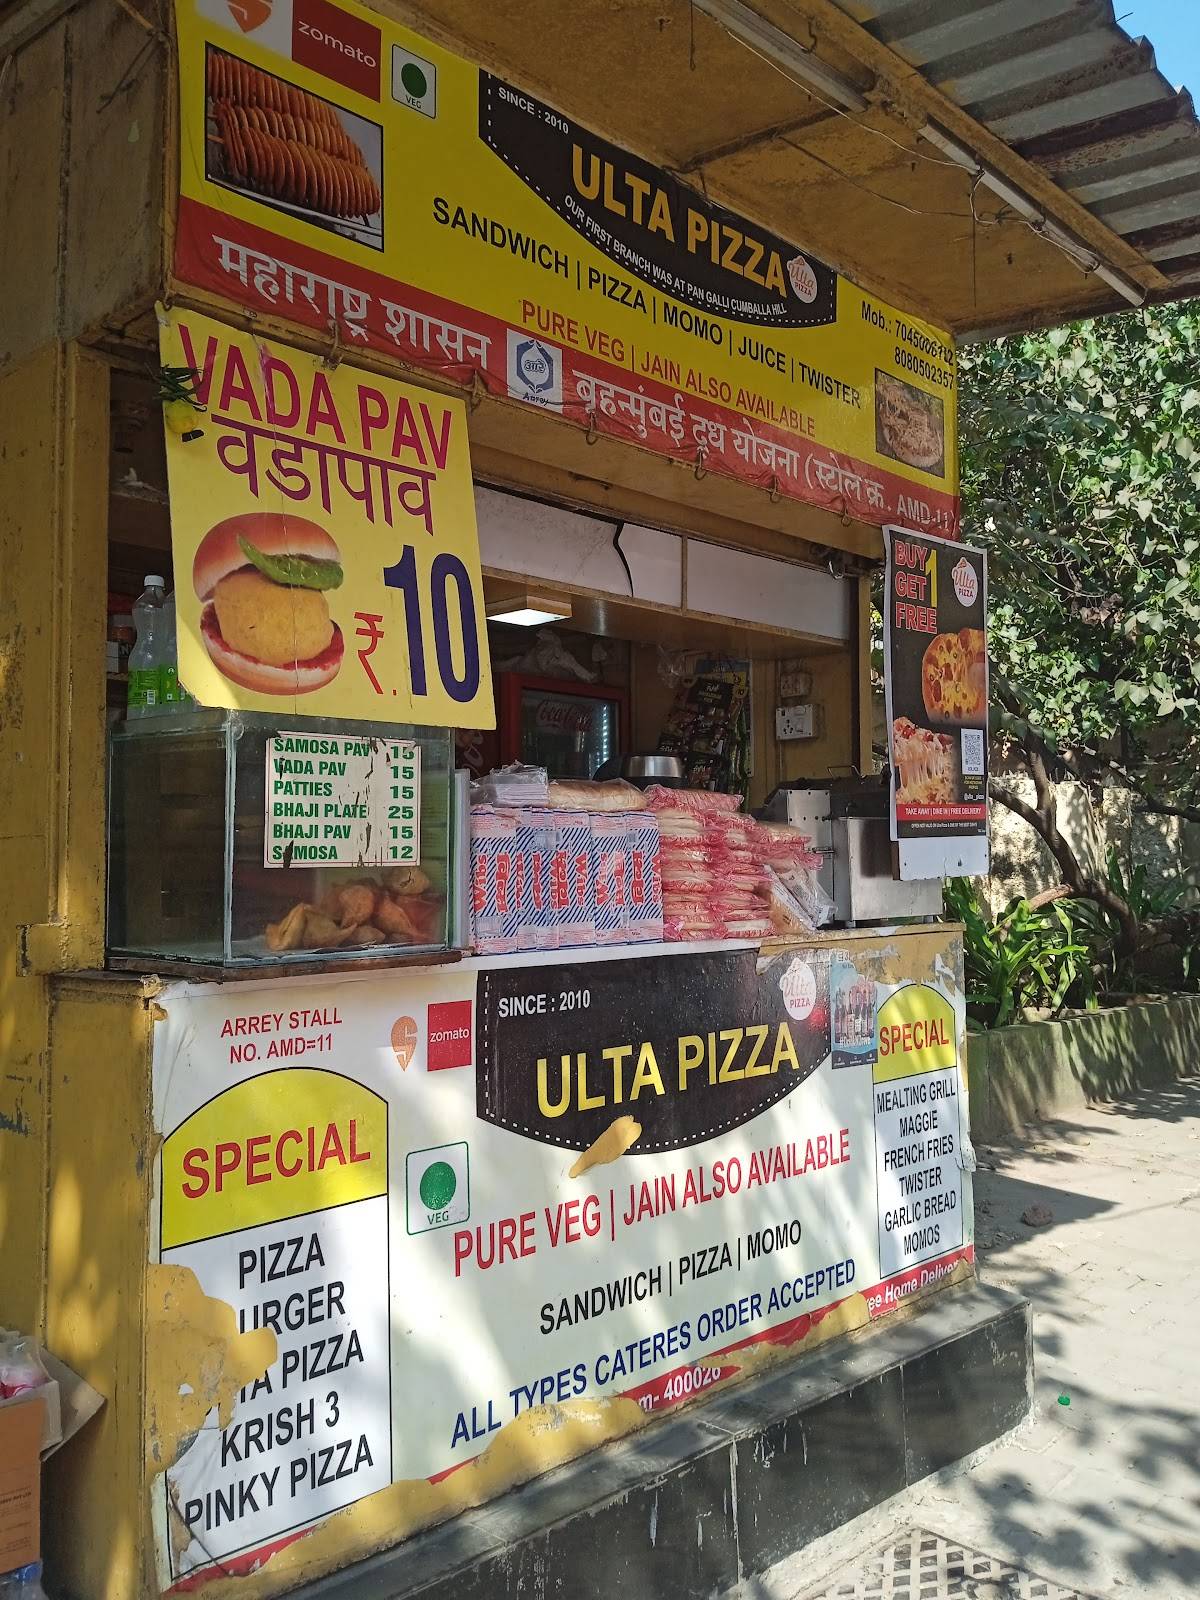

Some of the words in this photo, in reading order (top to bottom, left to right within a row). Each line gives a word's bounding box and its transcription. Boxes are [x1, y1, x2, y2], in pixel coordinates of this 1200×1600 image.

[298, 20, 376, 68] zomato
[405, 94, 422, 109] VEG
[497, 87, 535, 114] SINCE
[543, 110, 569, 134] 2010
[572, 144, 675, 243] ULTA
[687, 208, 787, 298] PIZZA
[564, 195, 584, 222] OUR
[585, 216, 612, 246] FIRST
[613, 241, 651, 273] BRANCH
[652, 265, 672, 285] WAS
[674, 275, 685, 291] AT
[687, 283, 704, 300] PAN
[706, 291, 730, 309] GALLI
[730, 299, 772, 315] CUMBALLA
[771, 302, 787, 315] HILL
[212, 234, 372, 342] महाराष्ट्र
[379, 298, 492, 371] शासन
[433, 196, 569, 278] SANDWICH
[589, 265, 646, 313] PIZZA
[664, 300, 723, 346] MOMO
[739, 338, 786, 373] JUICE
[799, 361, 861, 408] TWISTER
[794, 281, 811, 296] PIZZA
[862, 300, 891, 333] Mob.:
[522, 300, 578, 346] PURE
[585, 324, 625, 363] VEG
[641, 351, 680, 384] JAIN
[685, 369, 732, 403] ALSO
[735, 385, 816, 438] AVAILABLE
[895, 346, 954, 390] 8080502357
[177, 324, 346, 444] VADA
[357, 384, 452, 470] PAV
[731, 418, 800, 479] योजना
[211, 413, 436, 536] वडापाव
[895, 540, 928, 571] BUY
[925, 549, 937, 608] 1
[895, 571, 926, 601] GET
[958, 589, 974, 598] PIZZA
[383, 544, 481, 702] 10
[896, 602, 937, 634] FREE
[274, 738, 339, 754] SAMOSA
[344, 743, 370, 757] PAV
[274, 759, 314, 775] VADA
[319, 762, 346, 776] PAV
[390, 765, 414, 779] 15
[274, 780, 333, 797] PATTIES
[390, 786, 414, 799] 15
[273, 802, 319, 818] BHAJI
[324, 804, 367, 819] PLATE
[388, 806, 414, 819] 25
[273, 824, 319, 839] BHAJI
[324, 824, 351, 839] PAV
[390, 826, 414, 839] 15
[389, 846, 413, 859] 12
[473, 853, 488, 913] Wibs
[575, 852, 588, 906] Wibs
[220, 1012, 282, 1038] ARREY
[289, 1007, 342, 1030] STALL
[498, 993, 547, 1018] SINCE
[559, 990, 591, 1011] 2010
[790, 998, 810, 1008] PIZZA
[230, 1043, 261, 1064] NO.
[267, 1033, 333, 1059] AMD=11
[430, 1026, 469, 1042] zomato
[879, 1018, 949, 1056] SPECIAL
[536, 1041, 665, 1118] ULTA
[678, 1022, 800, 1091] PIZZA
[877, 1084, 927, 1114] MEALTING
[929, 1078, 956, 1100] GRILL
[899, 1110, 938, 1138] MAGGIE
[181, 1119, 371, 1199] SPECIAL
[884, 1143, 925, 1172] FRENCH
[927, 1134, 954, 1160] FRIES
[899, 1166, 942, 1197] TWISTER
[427, 1211, 449, 1225] VEG
[454, 1210, 536, 1278] PURE
[544, 1194, 600, 1244] VEG
[622, 1173, 676, 1226] JAIN
[682, 1156, 742, 1205] ALSO
[747, 1128, 851, 1190] AVAILABLE
[884, 1201, 921, 1232] GARLIC
[925, 1190, 956, 1216] BREAD
[239, 1232, 325, 1290] PIZZA
[903, 1224, 940, 1256] MOMOS
[539, 1265, 662, 1335] SANDWICH
[679, 1241, 732, 1285] PIZZA
[747, 1219, 802, 1260] MOMO
[866, 1294, 881, 1311] ree
[885, 1278, 917, 1304] Home
[239, 1280, 346, 1335] URGER
[282, 1329, 364, 1388] PIZZA
[451, 1400, 502, 1448] ALL
[509, 1363, 587, 1418] TYPES
[594, 1320, 691, 1386] CATERES
[696, 1292, 762, 1342] ORDER
[767, 1258, 856, 1311] ACCEPTED
[221, 1398, 315, 1467] KRISH
[325, 1390, 340, 1428] 3
[185, 1466, 280, 1531] PINKY
[290, 1434, 374, 1498] PIZZA
